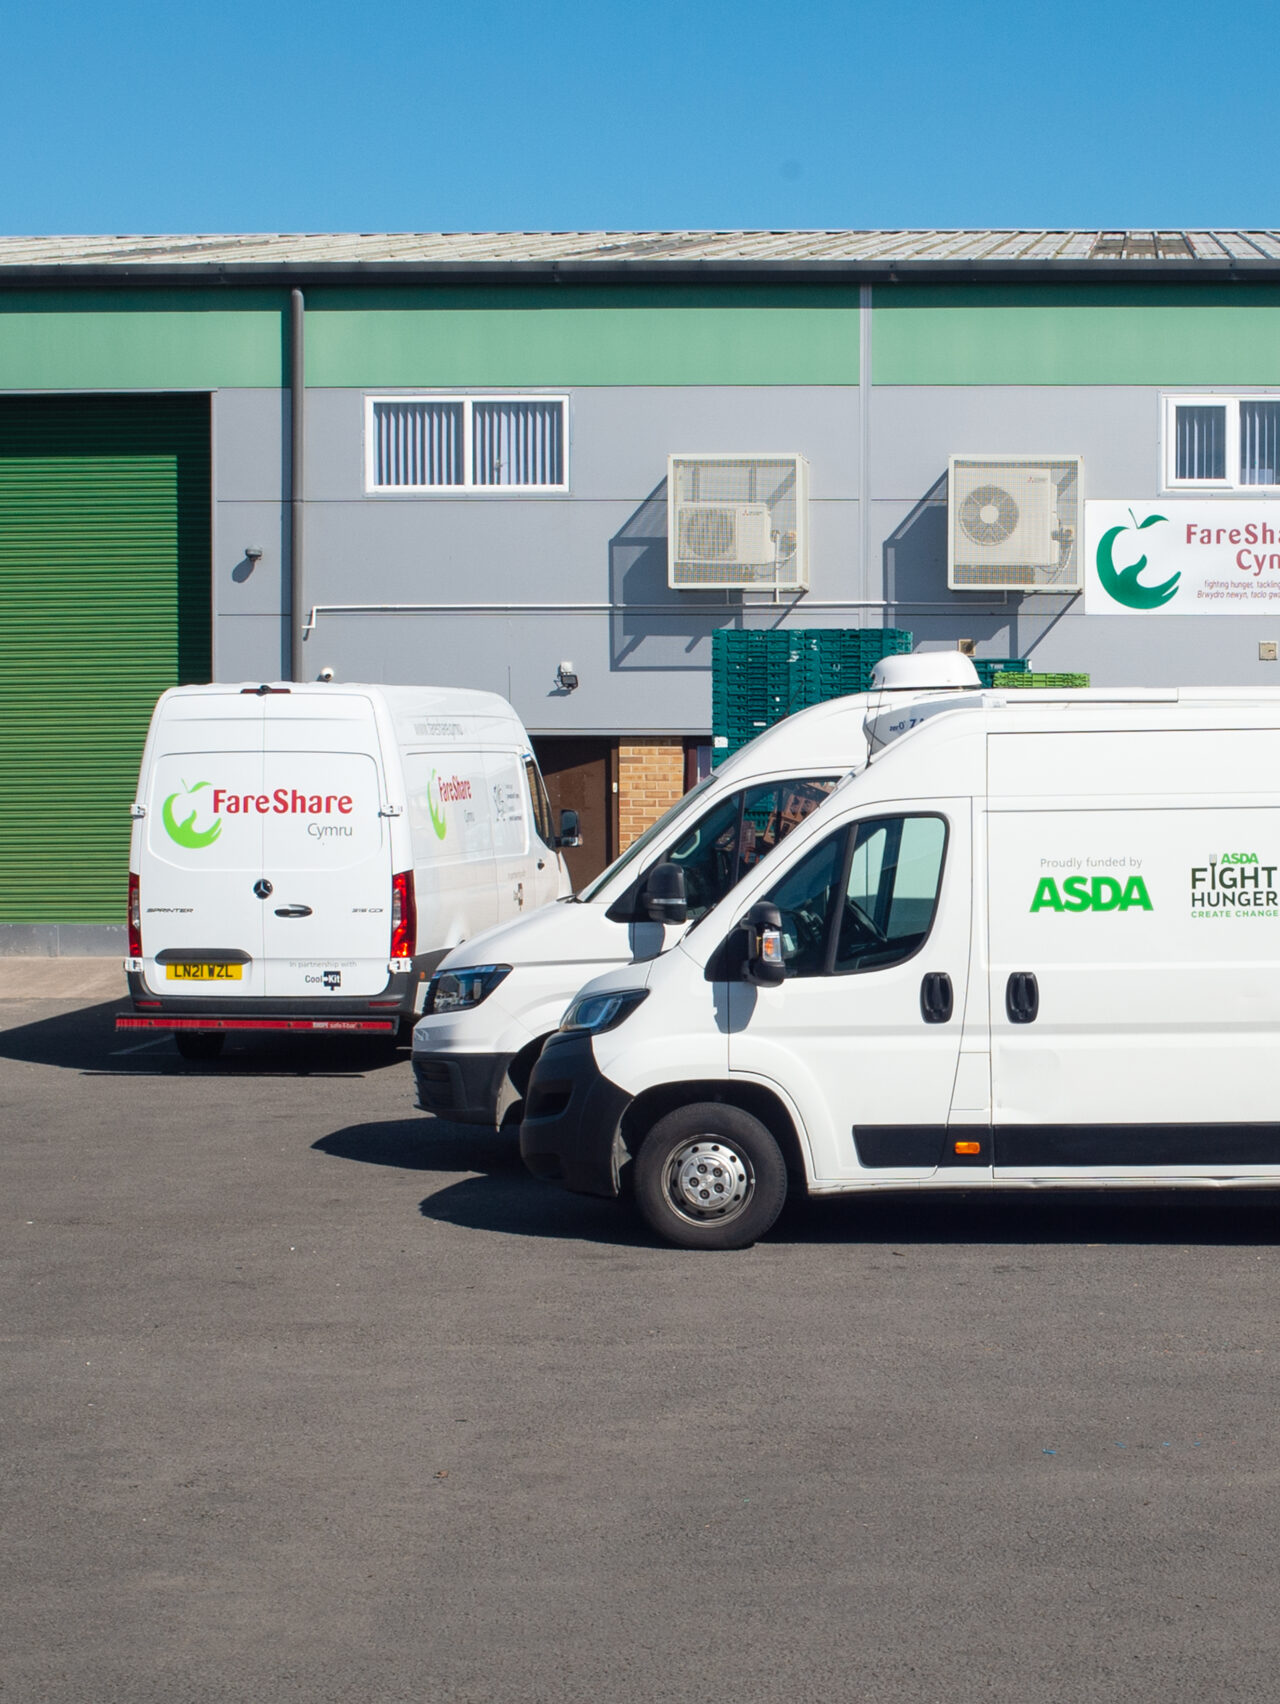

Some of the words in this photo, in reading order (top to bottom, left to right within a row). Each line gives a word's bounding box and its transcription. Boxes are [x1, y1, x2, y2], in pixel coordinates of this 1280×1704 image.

[1204, 580, 1229, 590] fighting
[213, 789, 353, 814] FareShare
[307, 822, 353, 840] Cymru
[1040, 857, 1082, 869] Proudly
[1086, 856, 1126, 867] funded
[1129, 856, 1143, 868] by
[1221, 852, 1259, 864] ASDA
[1191, 863, 1278, 890] FIGHT
[1029, 875, 1154, 912] ASDA
[1191, 891, 1278, 907] HUNGER
[1191, 910, 1231, 918] CREATE
[1235, 909, 1279, 917] CHANGE
[174, 963, 204, 978] LN21
[208, 963, 234, 978] WZL
[298, 961, 339, 969] partnership
[305, 974, 323, 983] Cool
